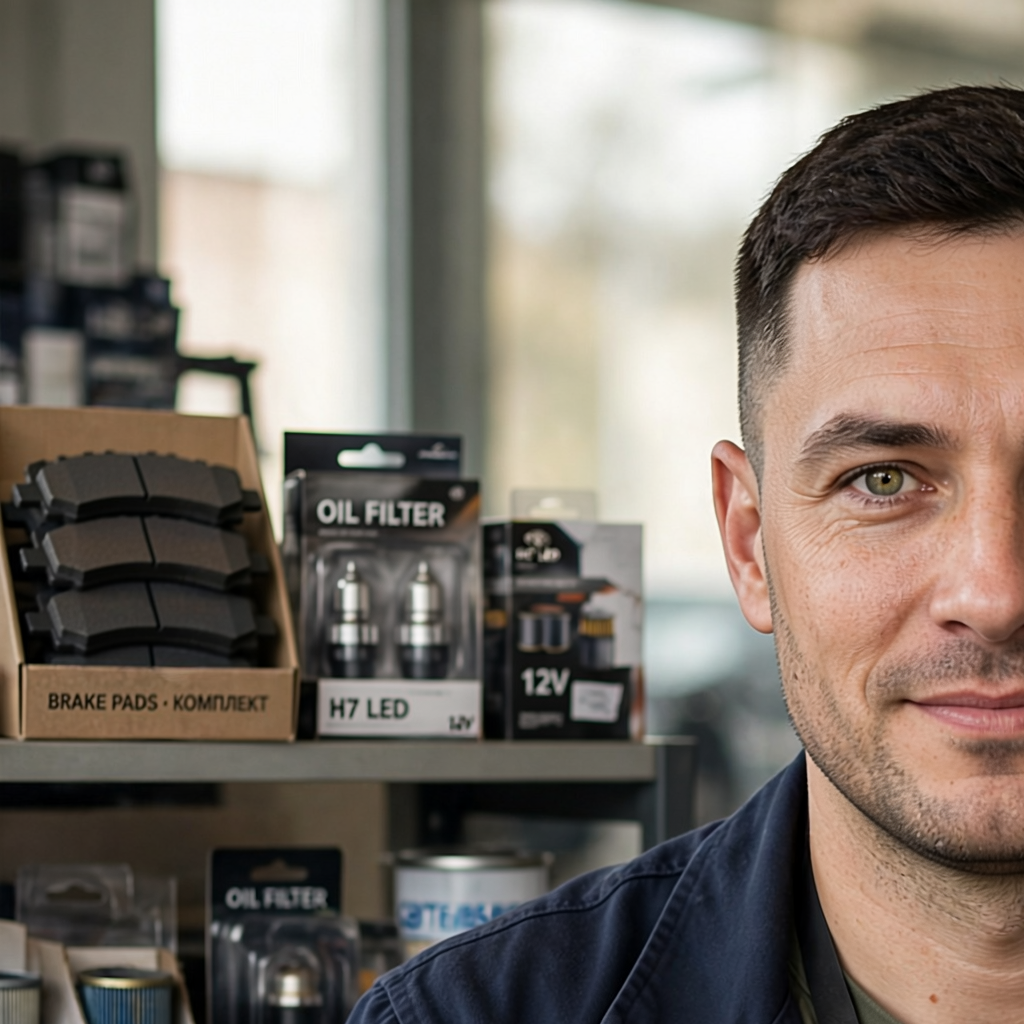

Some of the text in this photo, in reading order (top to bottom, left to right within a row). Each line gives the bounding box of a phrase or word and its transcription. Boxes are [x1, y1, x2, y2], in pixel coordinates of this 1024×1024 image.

[317, 499, 446, 527] OIL FILTER
[521, 667, 571, 696] 12V
[48, 693, 107, 710] BRAKE
[112, 693, 158, 711] PADS
[173, 694, 268, 712] КОМПЛЕКТ
[330, 697, 409, 719] H7 LED
[225, 886, 328, 909] OIL FILTER
